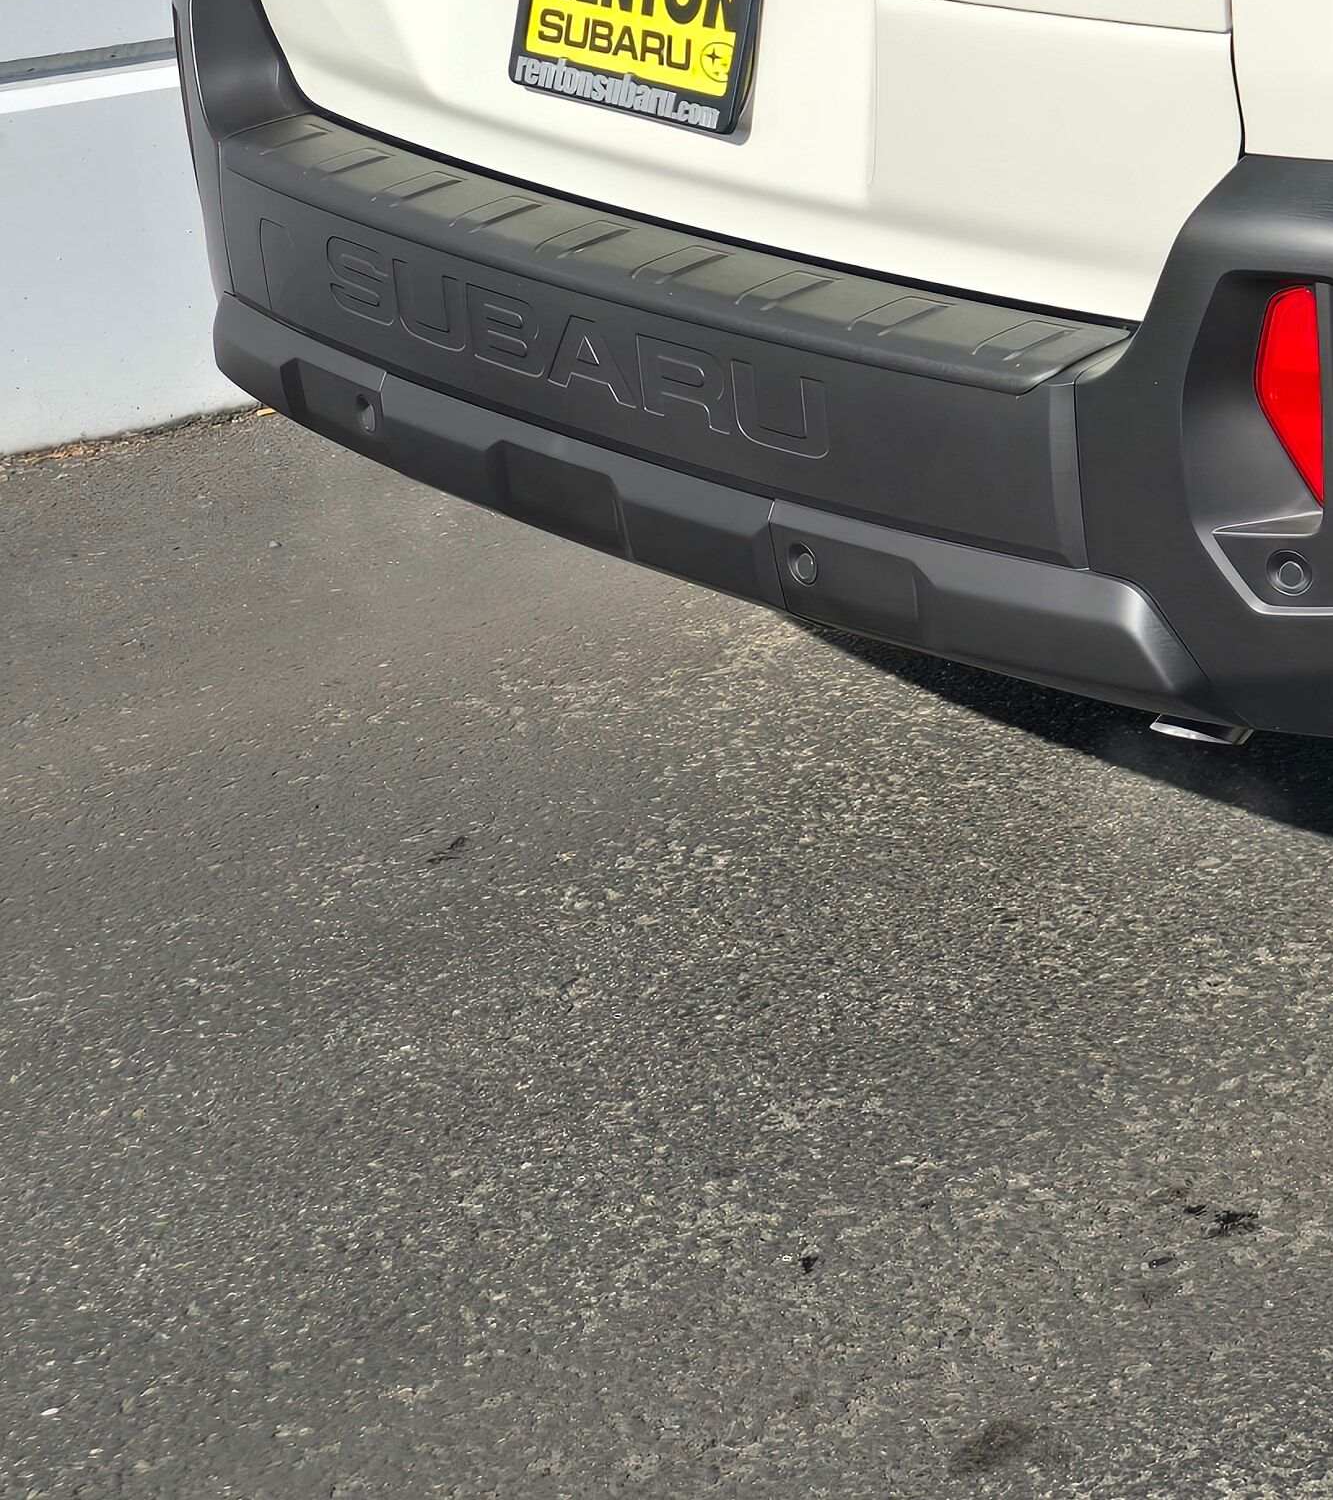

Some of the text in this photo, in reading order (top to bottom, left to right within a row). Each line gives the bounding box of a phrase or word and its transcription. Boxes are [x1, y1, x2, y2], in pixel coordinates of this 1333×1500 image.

[538, 8, 692, 71] SUBARU
[514, 55, 720, 130] rentonsubaru.com
[326, 233, 830, 460] SUBARU
